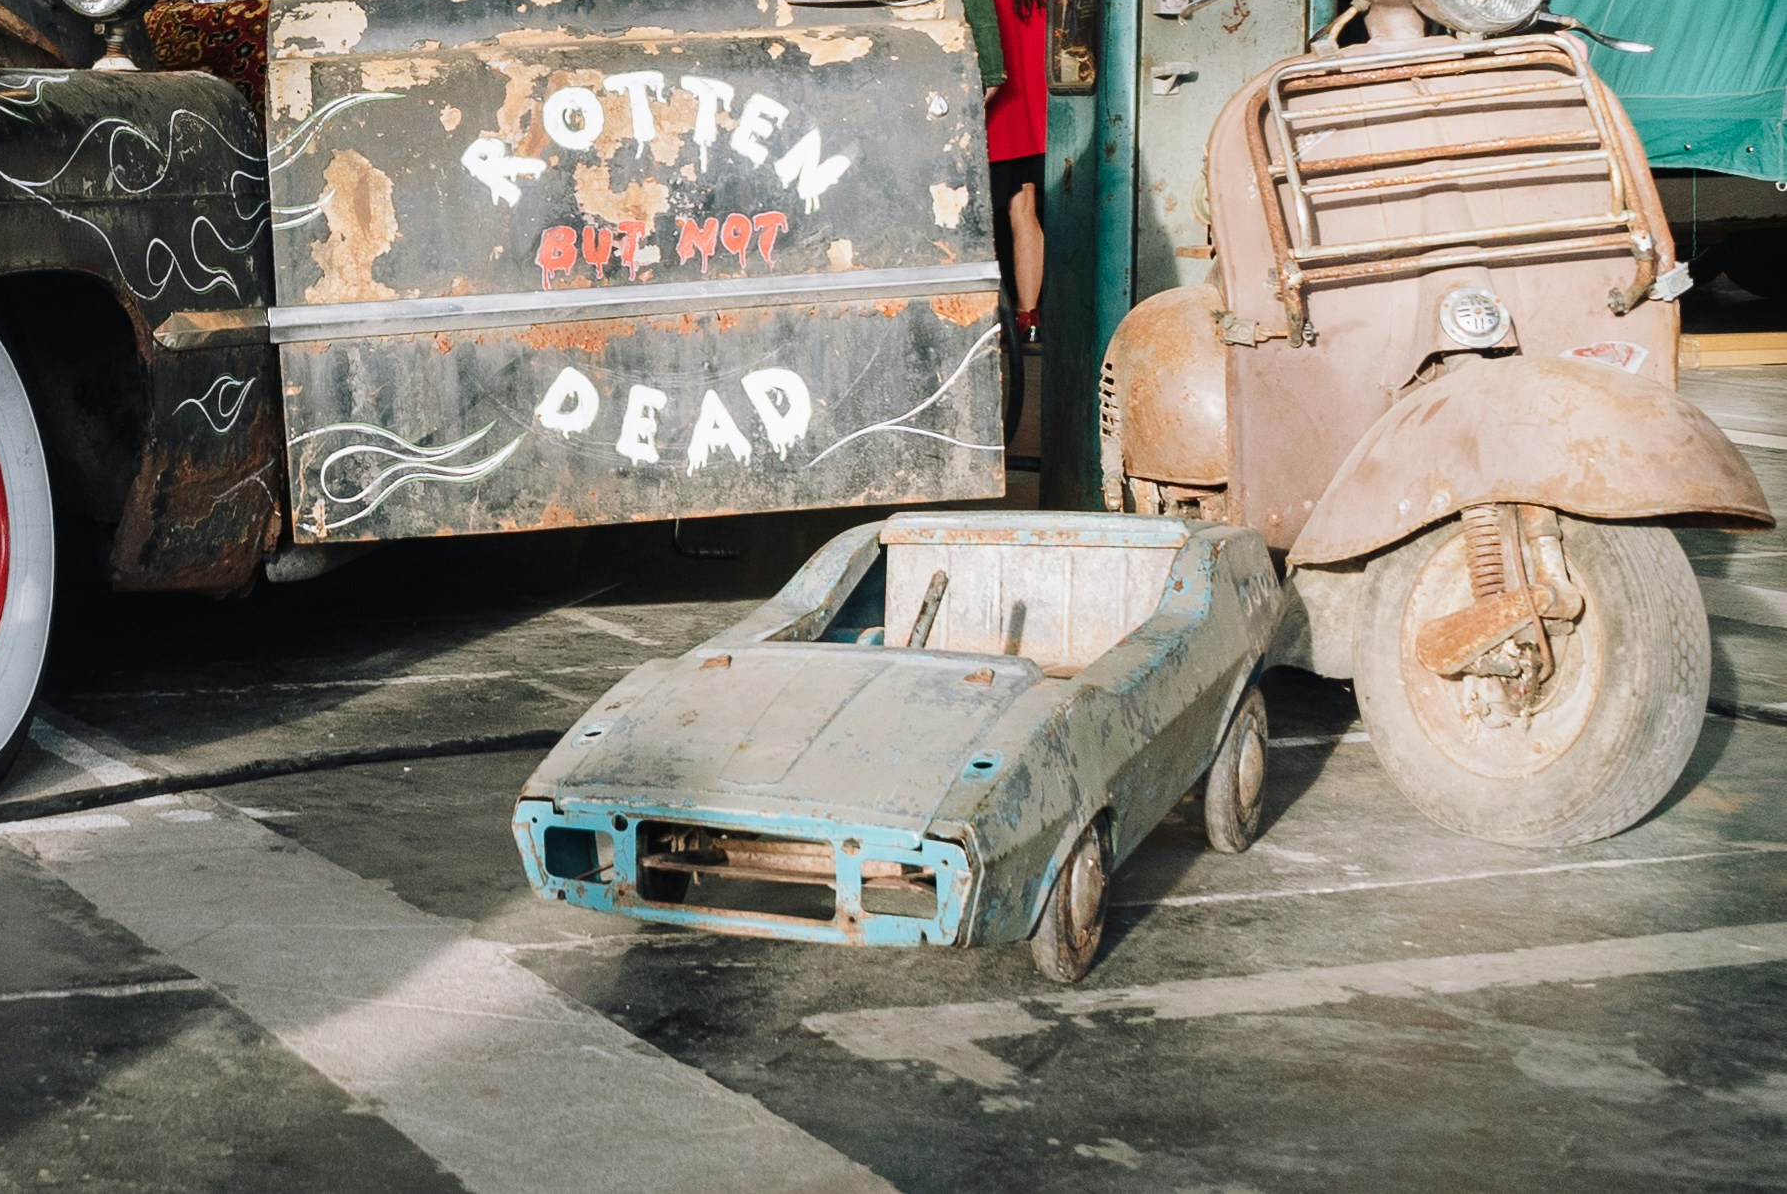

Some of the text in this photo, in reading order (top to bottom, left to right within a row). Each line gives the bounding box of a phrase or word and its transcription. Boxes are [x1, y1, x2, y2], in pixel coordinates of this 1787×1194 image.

[460, 70, 853, 215] ROTTEN
[535, 211, 789, 290] BUT NOT
[534, 366, 812, 477] DEAD
